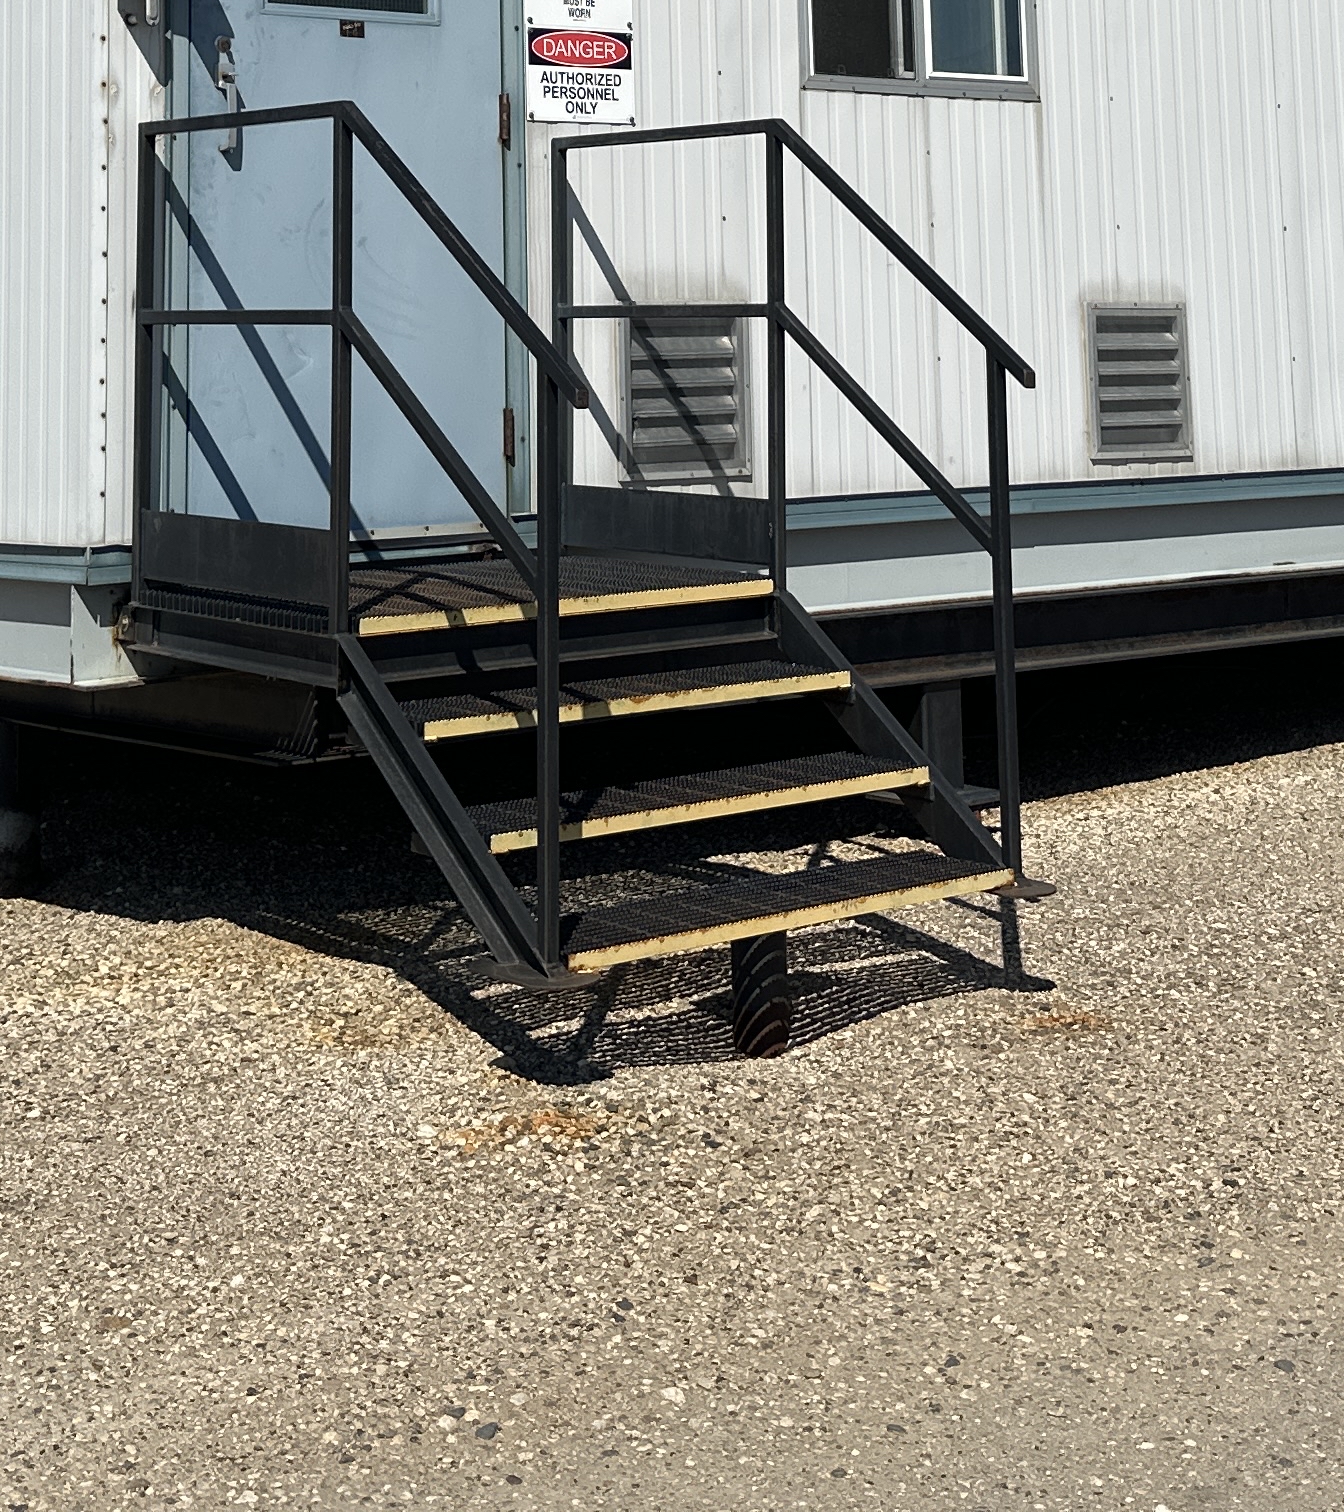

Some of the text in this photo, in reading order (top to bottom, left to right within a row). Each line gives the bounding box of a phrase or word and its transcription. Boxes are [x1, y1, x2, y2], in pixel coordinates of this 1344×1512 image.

[568, 7, 592, 18] WORN
[543, 38, 617, 60] DANGER
[540, 71, 622, 86] AUTHORIZED
[543, 85, 619, 101] PERSONNEL
[565, 100, 599, 114] ONLY
